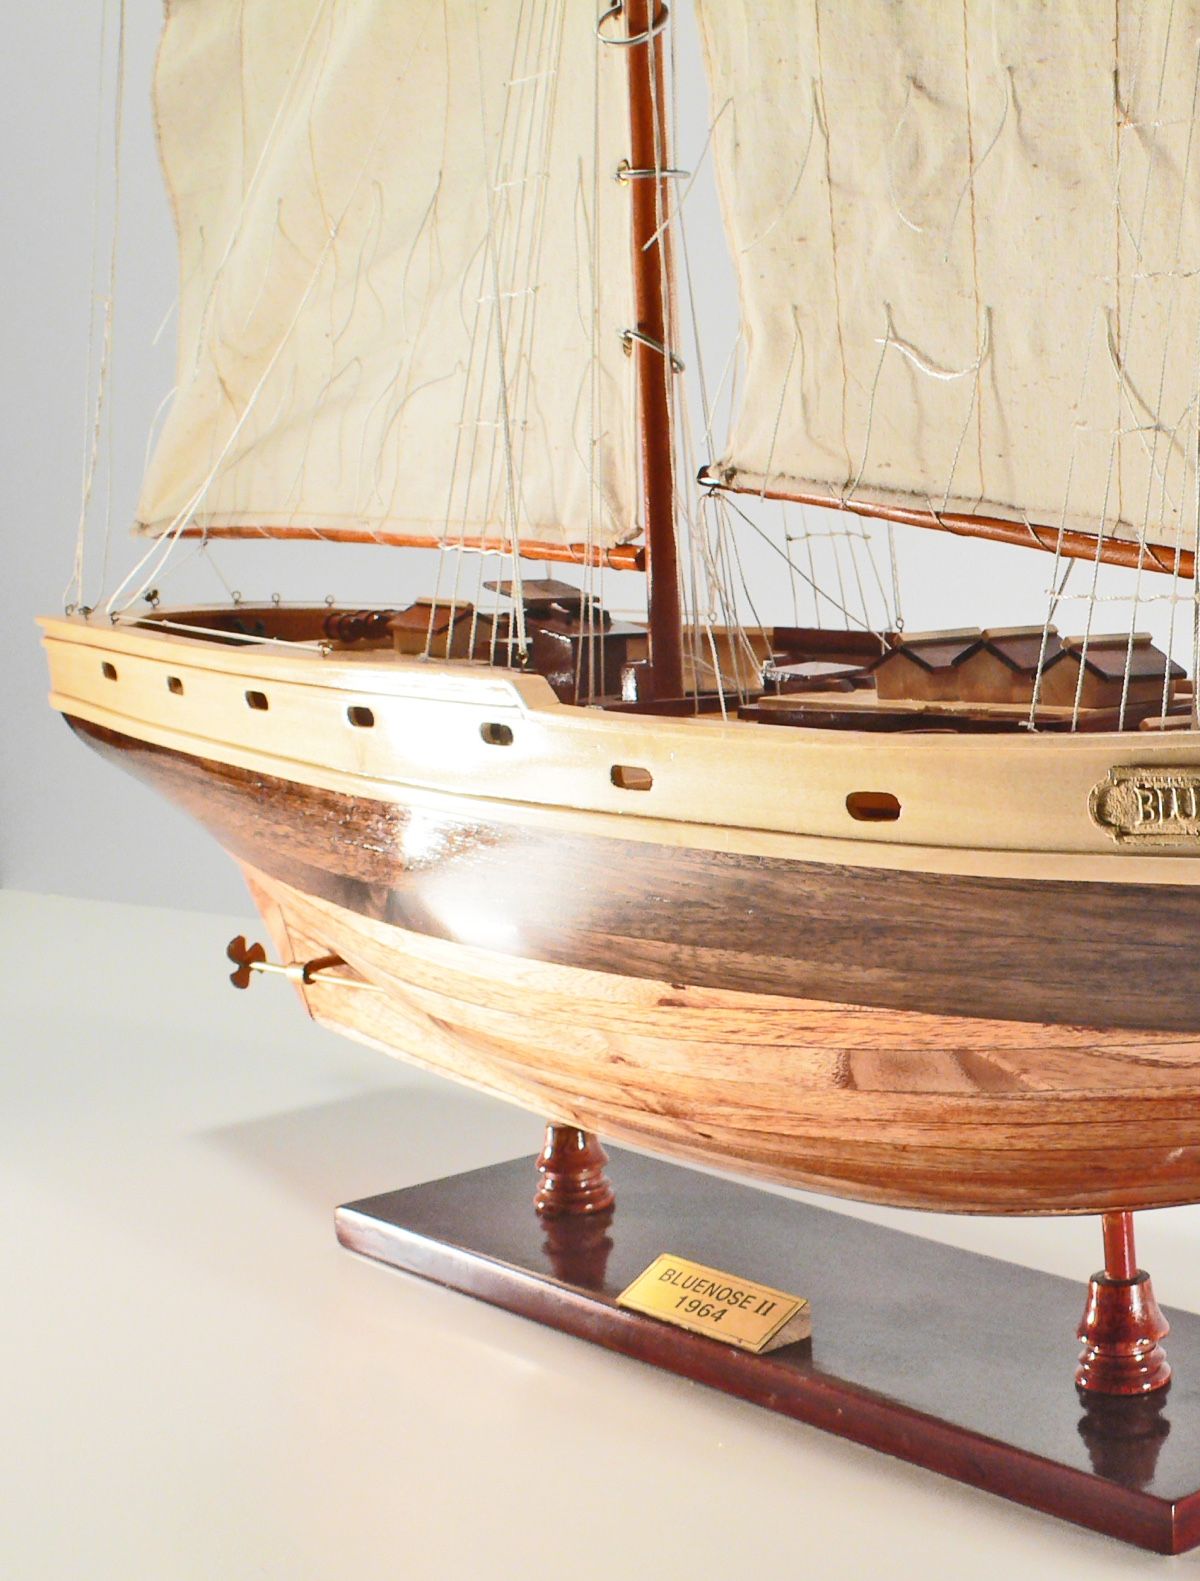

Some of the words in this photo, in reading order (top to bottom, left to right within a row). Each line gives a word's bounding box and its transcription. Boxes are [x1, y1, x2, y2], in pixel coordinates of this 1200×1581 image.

[658, 1268, 757, 1310] BLUENOSE
[753, 1299, 778, 1317] II
[674, 1295, 728, 1323] 1964
